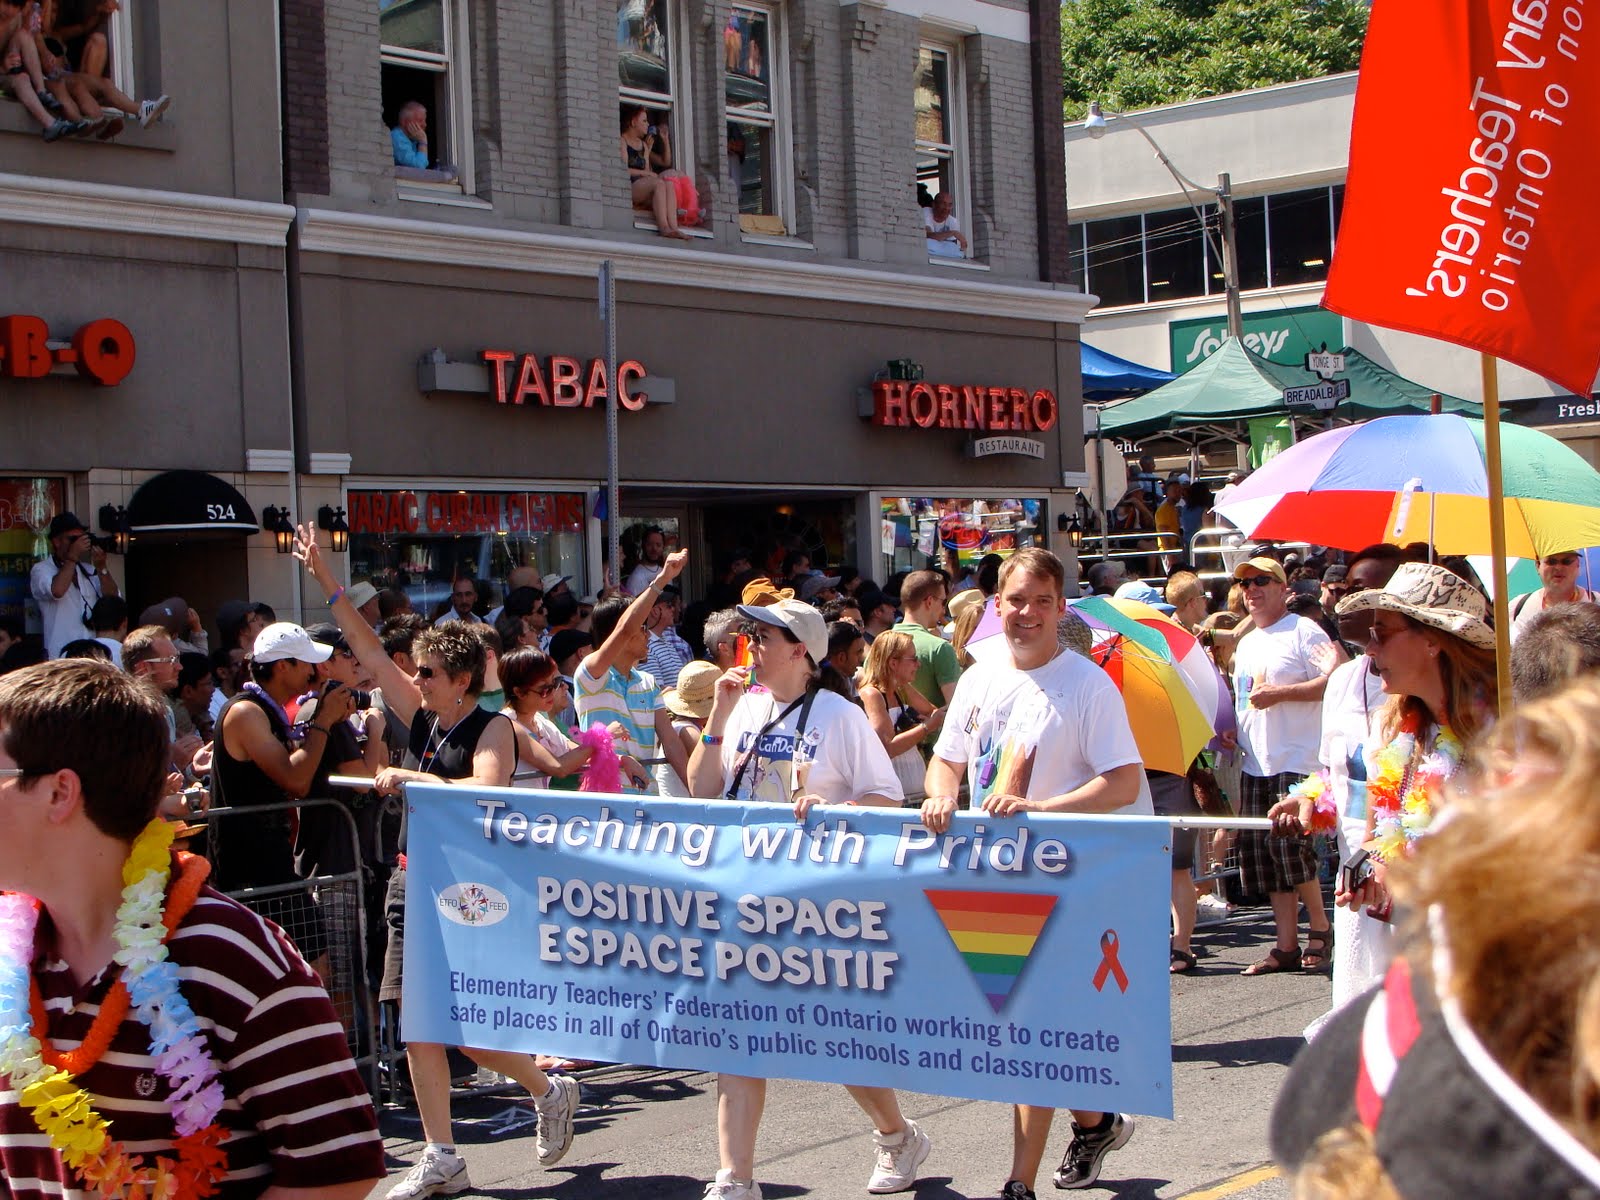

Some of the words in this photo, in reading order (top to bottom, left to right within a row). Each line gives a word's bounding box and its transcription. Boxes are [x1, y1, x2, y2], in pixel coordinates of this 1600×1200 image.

[1186, 328, 1289, 363] Soeys
[1312, 356, 1330, 368] YONGE
[482, 350, 648, 411] TABAC
[880, 381, 1058, 432] HORNERO
[979, 439, 1042, 455] RESTAURANT
[207, 504, 236, 520] 524
[349, 492, 418, 533] TABAC
[426, 492, 501, 533] CUBAN
[507, 493, 583, 533] CIGARS
[475, 799, 717, 867] Teaching
[742, 818, 866, 866] with
[893, 823, 1070, 874] Pride
[440, 899, 458, 908] ETFO
[489, 901, 508, 912] FEEO
[537, 876, 721, 931] POSITIVE
[737, 894, 889, 942] SPACE
[538, 923, 704, 977] ESPACE
[715, 940, 899, 992] POSITIF
[450, 971, 558, 1005] Elementary
[664, 991, 778, 1022] Federation
[786, 1004, 805, 1025] of
[813, 1003, 897, 1034] Ontario
[905, 1015, 1001, 1047] working
[1008, 1022, 1031, 1045] to
[1039, 1028, 1120, 1053] create
[450, 1002, 486, 1024] safe
[493, 1006, 557, 1032] places
[564, 1011, 582, 1034] in
[589, 1013, 613, 1038] all
[621, 1018, 640, 1040] of
[747, 1032, 817, 1056] public
[825, 1037, 910, 1067] schools
[918, 1047, 962, 1072] and
[971, 1051, 1120, 1087] classrooms.
